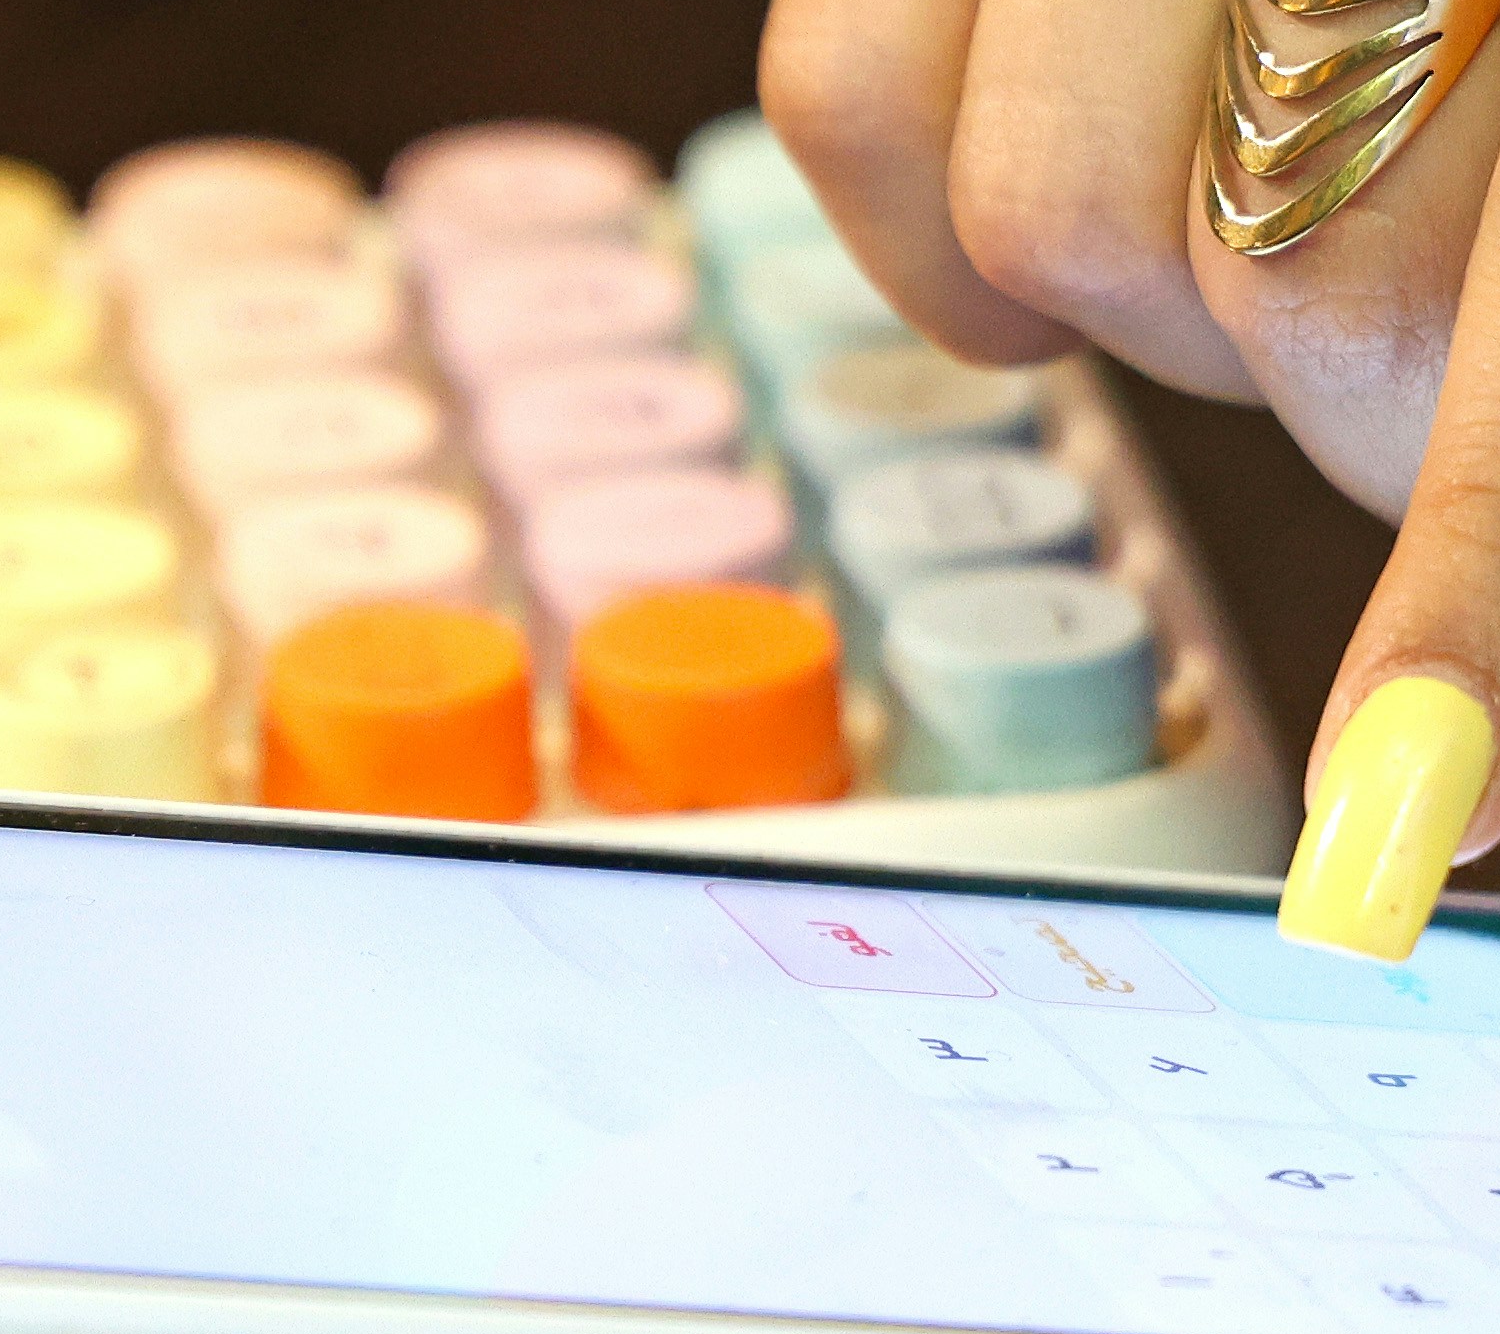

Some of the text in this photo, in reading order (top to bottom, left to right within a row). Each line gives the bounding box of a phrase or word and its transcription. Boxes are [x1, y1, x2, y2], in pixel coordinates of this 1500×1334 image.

[805, 919, 894, 959] لغو
[1011, 916, 1137, 995] تصحیح
[917, 1036, 990, 1062] ۳
[1149, 1054, 1208, 1077] ۶
[1367, 1071, 1418, 1089] ۹
[1038, 1153, 1098, 1174] ۲
[1266, 1168, 1327, 1191] ۵
